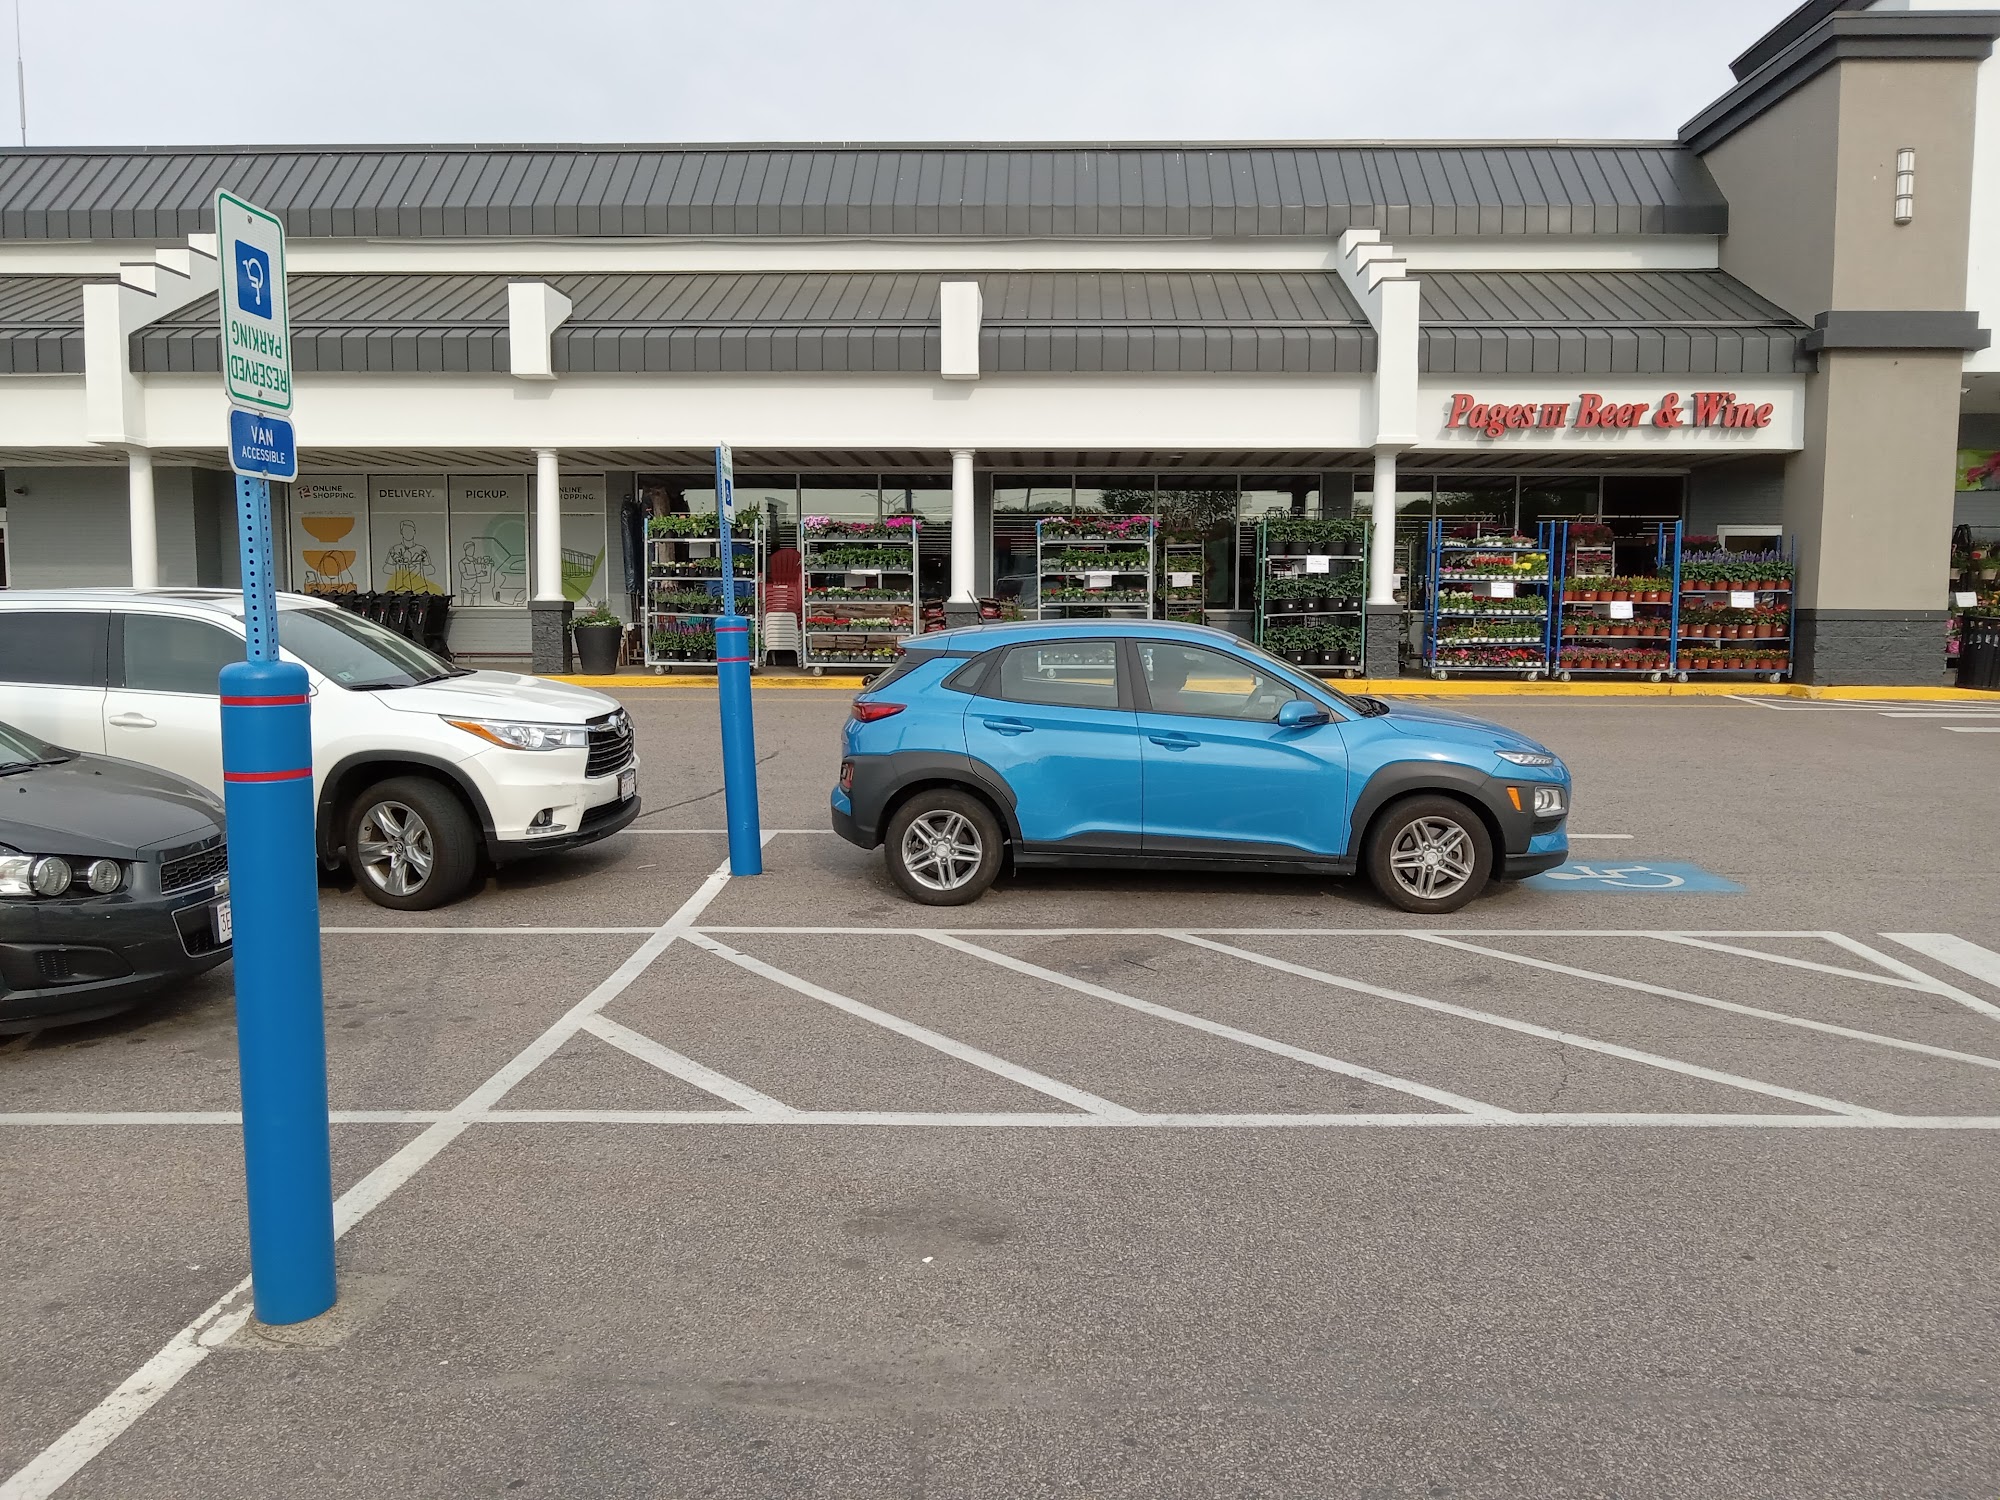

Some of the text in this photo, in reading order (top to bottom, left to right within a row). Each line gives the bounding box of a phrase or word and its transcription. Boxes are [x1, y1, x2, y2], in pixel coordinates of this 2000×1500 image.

[232, 320, 282, 359] PARKING
[231, 355, 287, 392] RESERVED
[1447, 393, 1537, 438] Pages
[1574, 393, 1649, 429] Beer
[1652, 392, 1684, 428] &
[1691, 392, 1774, 429] Wine
[250, 425, 273, 447] VAN
[242, 445, 285, 464] ACCESSIBLE
[379, 489, 435, 498] DELIVERY.
[465, 489, 509, 499] PICKUP.
[559, 486, 583, 494] NLINE
